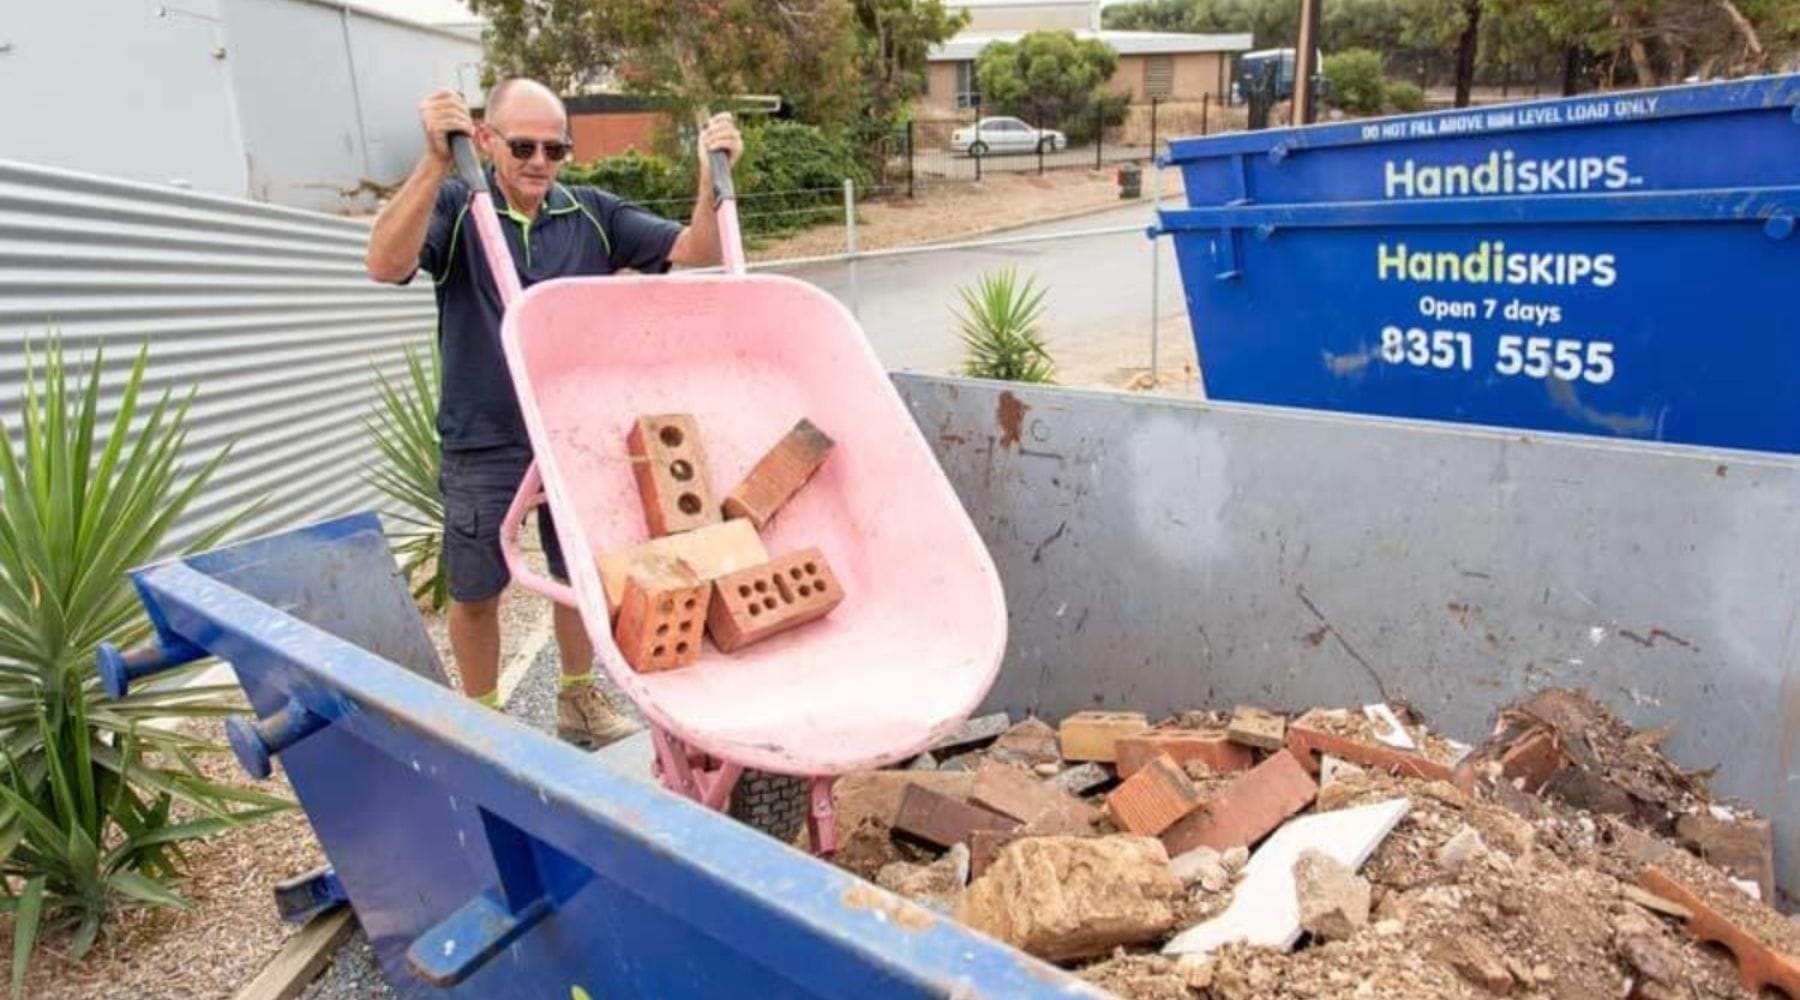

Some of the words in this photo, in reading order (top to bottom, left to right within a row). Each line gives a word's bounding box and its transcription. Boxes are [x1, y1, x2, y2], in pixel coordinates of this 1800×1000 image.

[1362, 126, 1378, 139] DO
[1382, 123, 1406, 137] NOT
[1410, 119, 1435, 135] FILL
[1518, 107, 1562, 126] LEVEL
[1567, 103, 1608, 120] LOAD
[1614, 97, 1659, 117] ONLY
[1419, 296, 1476, 320] Open
[1483, 299, 1498, 319] 7
[1504, 298, 1562, 326] days
[1380, 325, 1473, 371] 8351
[1495, 335, 1615, 384] 5555
